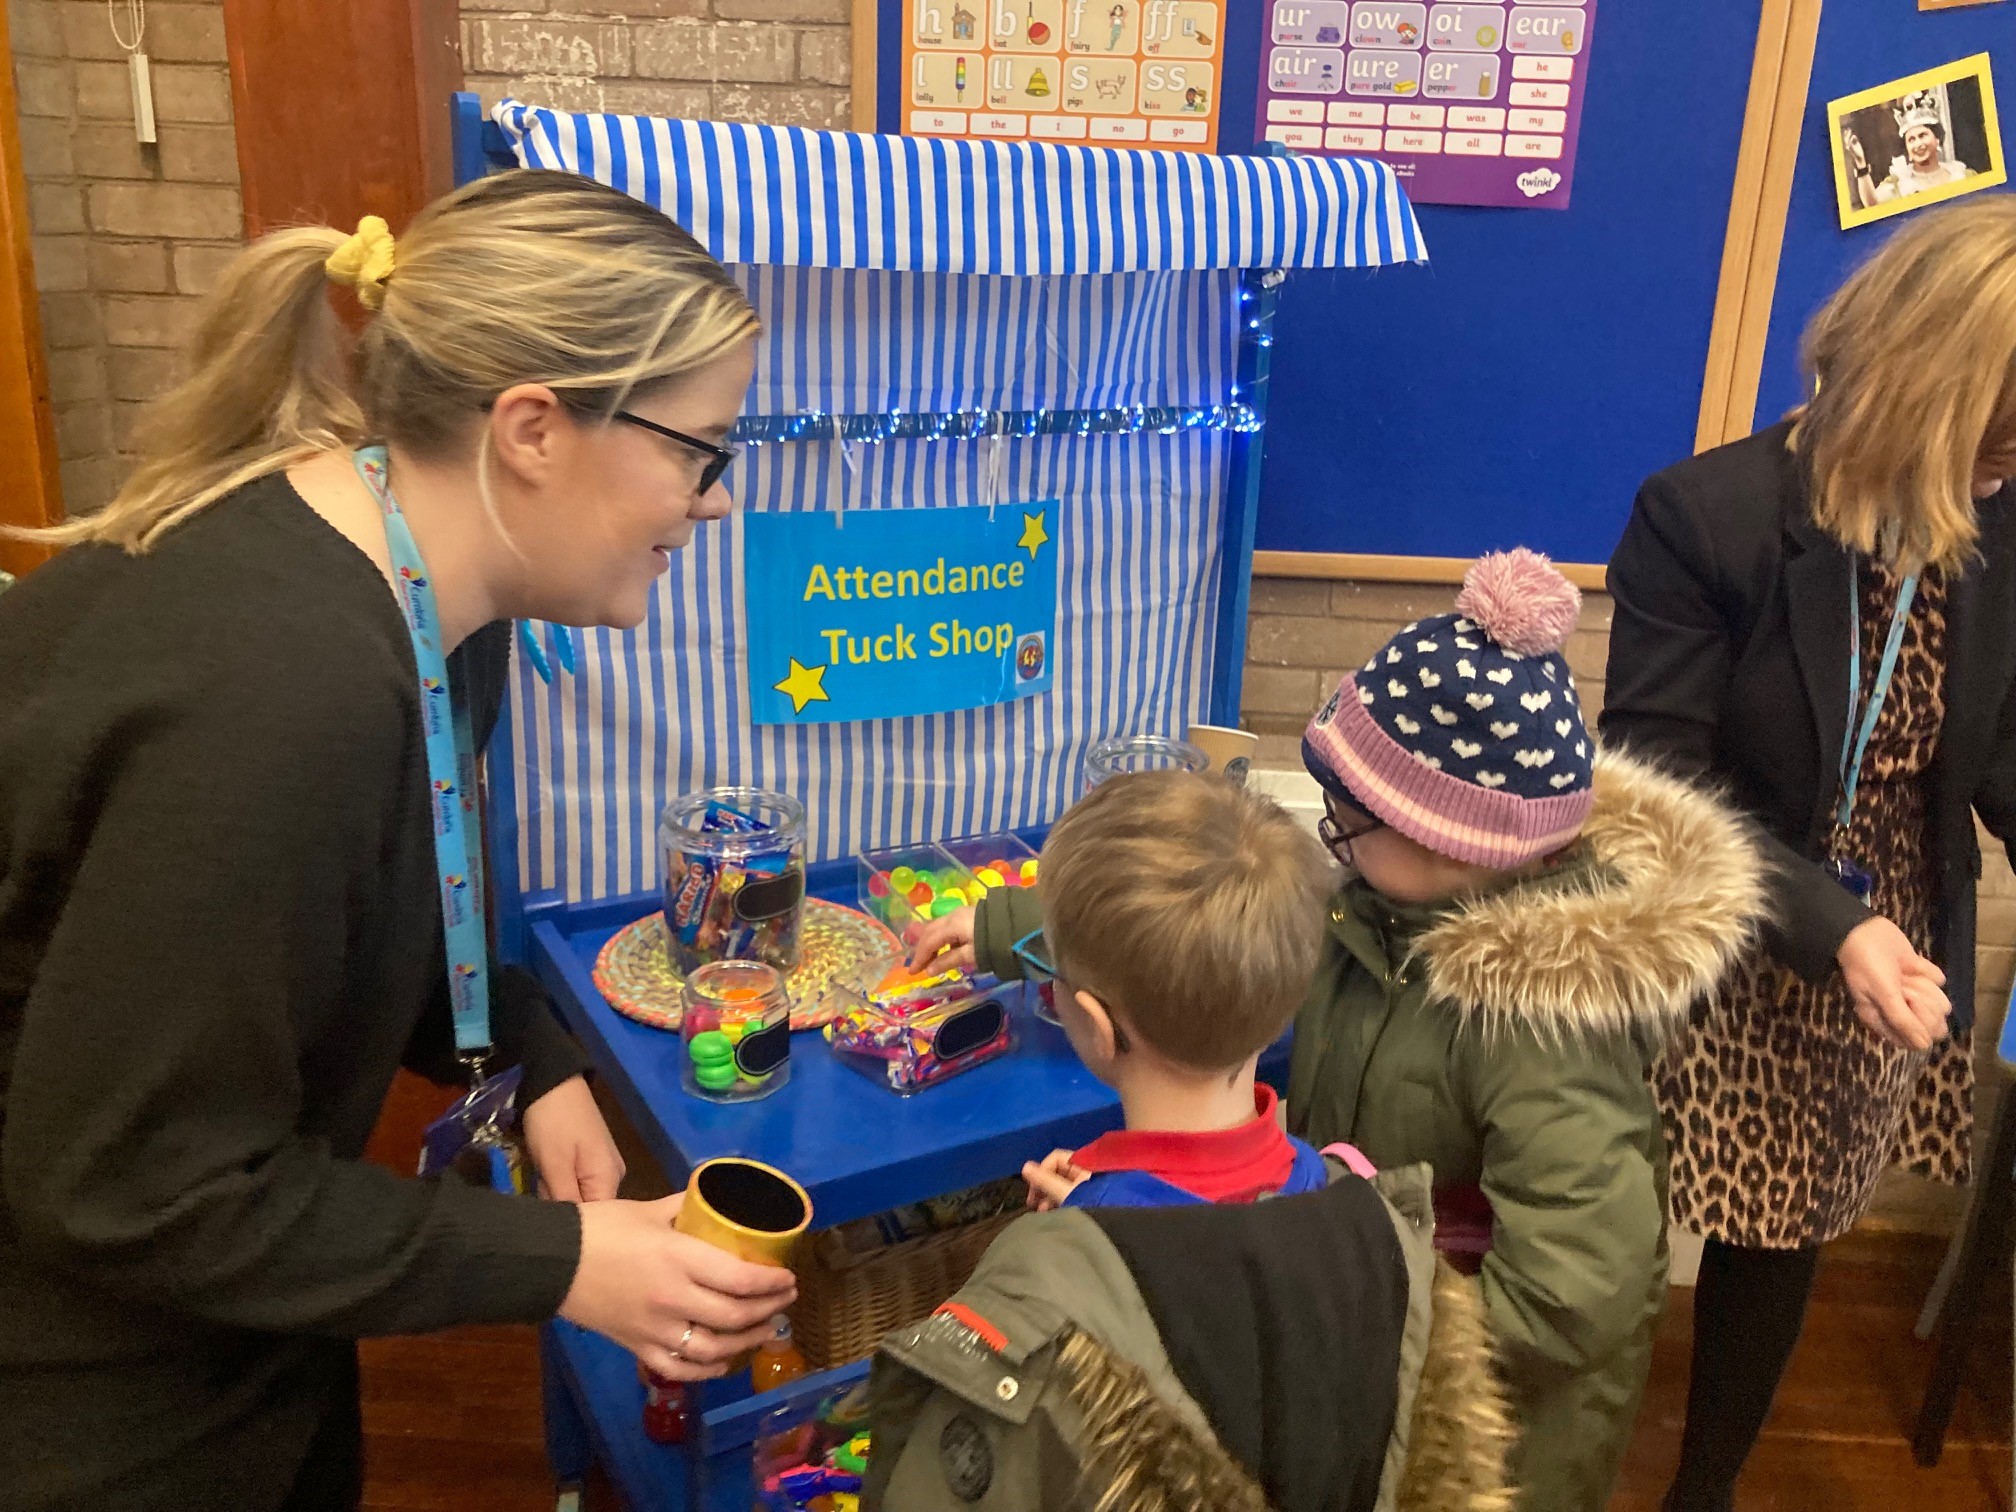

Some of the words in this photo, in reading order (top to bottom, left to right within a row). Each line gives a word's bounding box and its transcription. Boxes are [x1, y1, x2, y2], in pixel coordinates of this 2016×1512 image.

[917, 0, 943, 35] h
[997, 0, 1017, 37] b
[1069, 0, 1088, 39] f
[1145, 0, 1180, 42] ff
[1278, 5, 1311, 27] ur
[1356, 10, 1400, 31] ow
[1435, 6, 1463, 33] oi
[1515, 15, 1566, 36] ear
[917, 35, 942, 45] house
[1278, 33, 1303, 43] purse
[1355, 35, 1382, 44] clown
[1432, 37, 1452, 46] coin
[1070, 41, 1090, 52] fairy
[1147, 43, 1160, 53] off
[1274, 50, 1317, 76] air
[1352, 57, 1399, 79] ure
[1537, 63, 1549, 72] he
[1428, 61, 1459, 82] er
[1069, 65, 1089, 91] s
[1145, 65, 1186, 92] ss
[1274, 79, 1297, 89] chair
[1350, 82, 1370, 93] pure
[1373, 81, 1392, 93] gold
[1427, 83, 1457, 94] pepper
[916, 92, 934, 104] lolly
[991, 95, 1007, 104] bell
[1531, 89, 1547, 99] she
[1067, 97, 1084, 107] pigs
[1144, 101, 1161, 110] kiss
[1289, 107, 1303, 116] we
[1349, 110, 1363, 119] me
[1410, 111, 1421, 121] be
[933, 118, 944, 128] to
[1466, 114, 1486, 123] was
[1529, 116, 1544, 127] my
[990, 119, 1007, 130] the
[1112, 125, 1125, 133] no
[1172, 127, 1185, 137] go
[1285, 132, 1302, 142] you
[1343, 134, 1364, 146] they
[1403, 136, 1423, 146] here
[1467, 139, 1480, 148] all
[1525, 142, 1541, 151] are
[1520, 176, 1552, 188] twinkl
[803, 557, 1025, 601] Attendance
[820, 623, 918, 665] Tuck
[929, 619, 1014, 658] Shop
[675, 863, 704, 927] HARIBO
